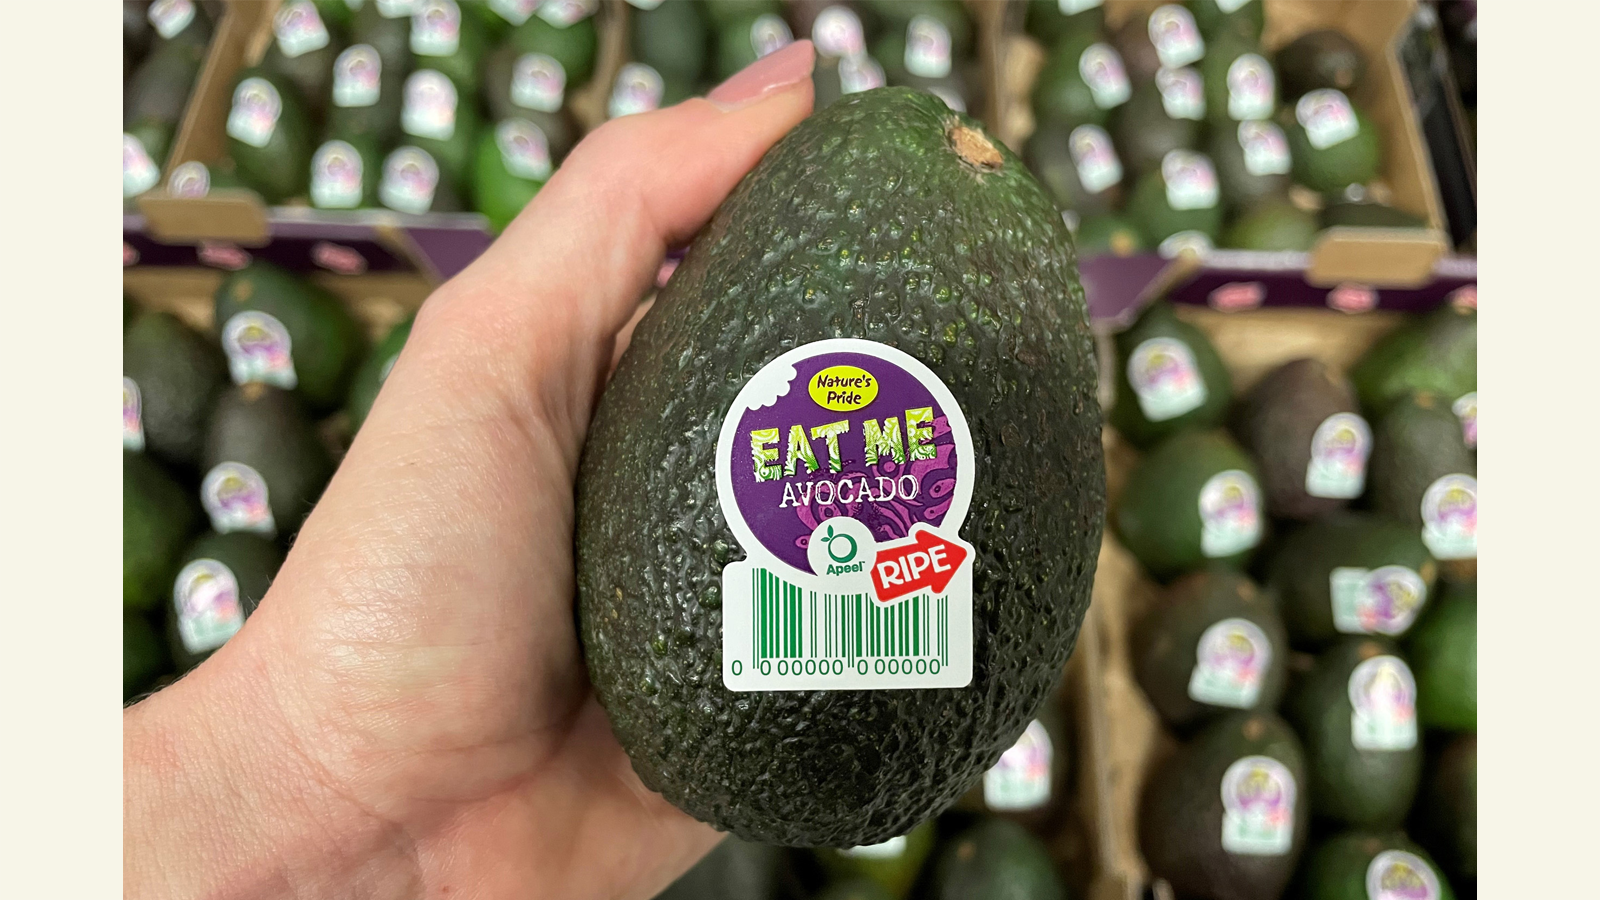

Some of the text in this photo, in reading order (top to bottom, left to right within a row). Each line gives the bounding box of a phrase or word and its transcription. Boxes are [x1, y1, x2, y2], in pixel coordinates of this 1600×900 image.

[817, 374, 872, 390] Nature's
[826, 391, 862, 406] Pride
[751, 406, 938, 482] EAT ME
[779, 474, 920, 508] AVOCADO
[876, 544, 951, 589] RIPE
